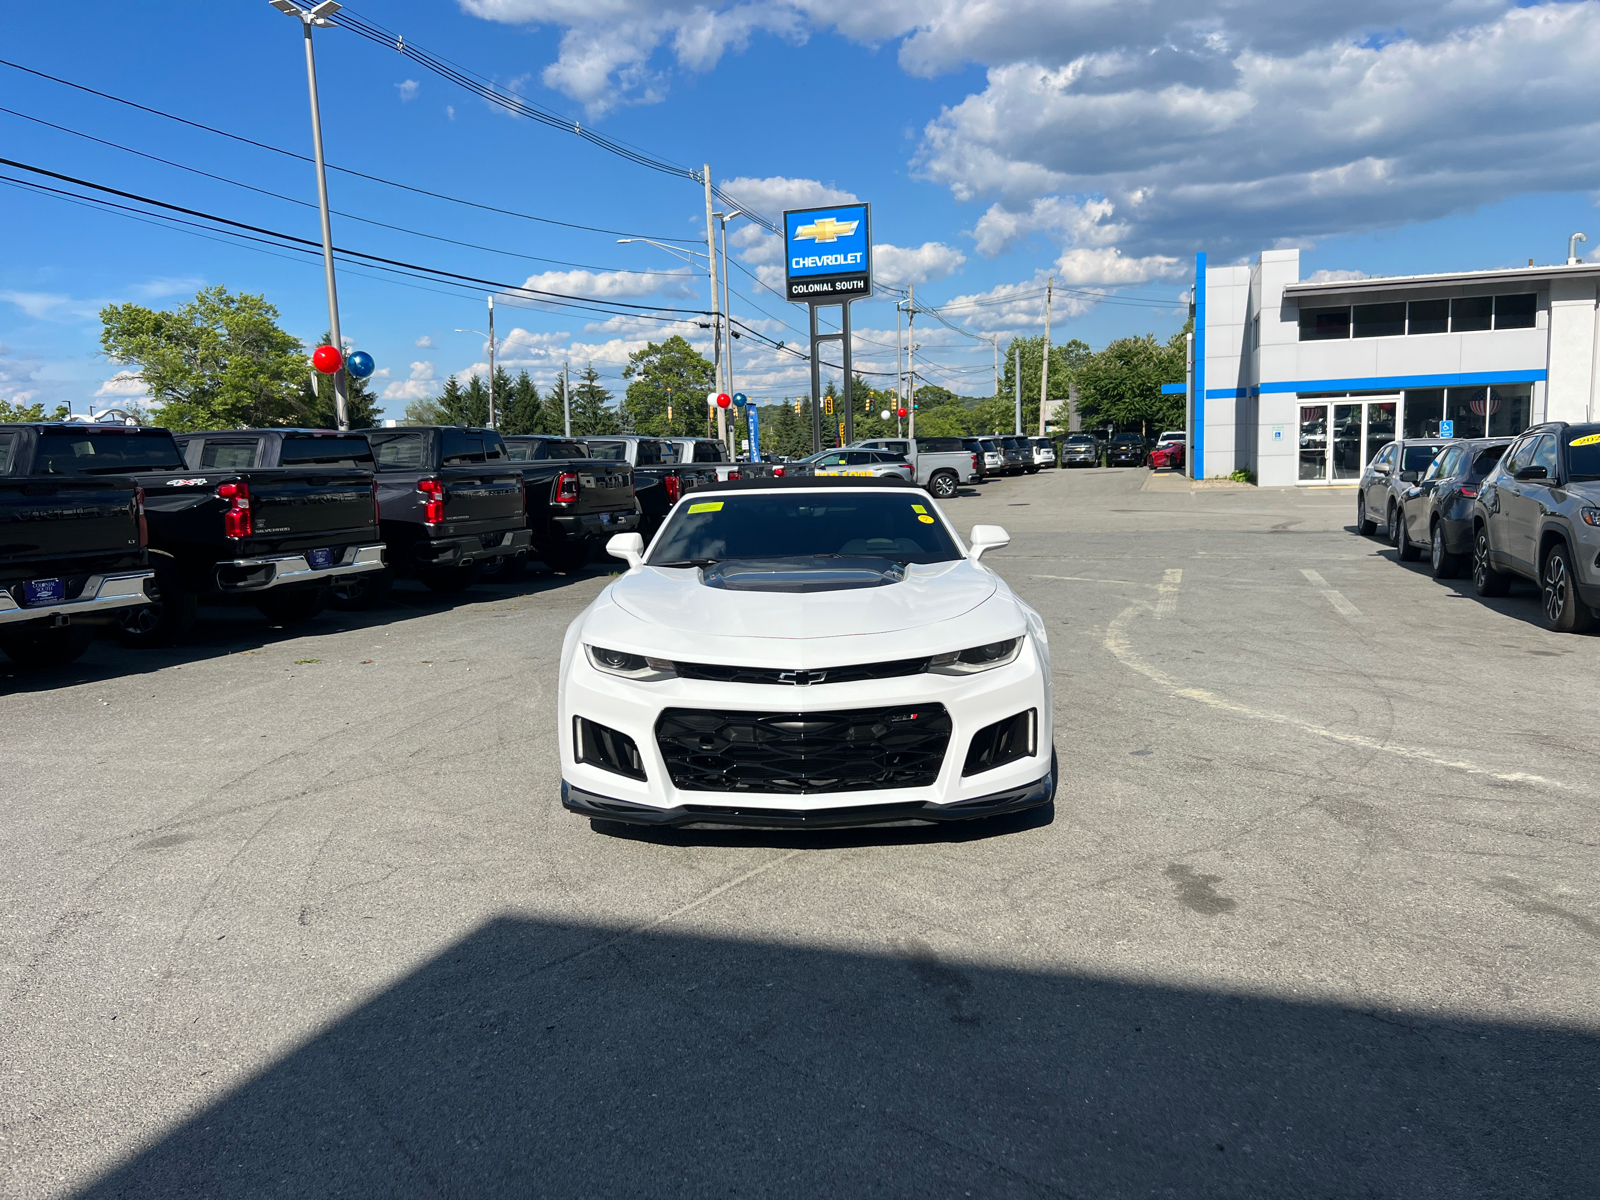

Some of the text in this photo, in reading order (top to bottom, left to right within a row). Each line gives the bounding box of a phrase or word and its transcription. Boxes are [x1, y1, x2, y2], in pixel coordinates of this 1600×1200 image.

[792, 252, 862, 268] CHEVROLET
[792, 280, 864, 294] COLONIAL SOUTH
